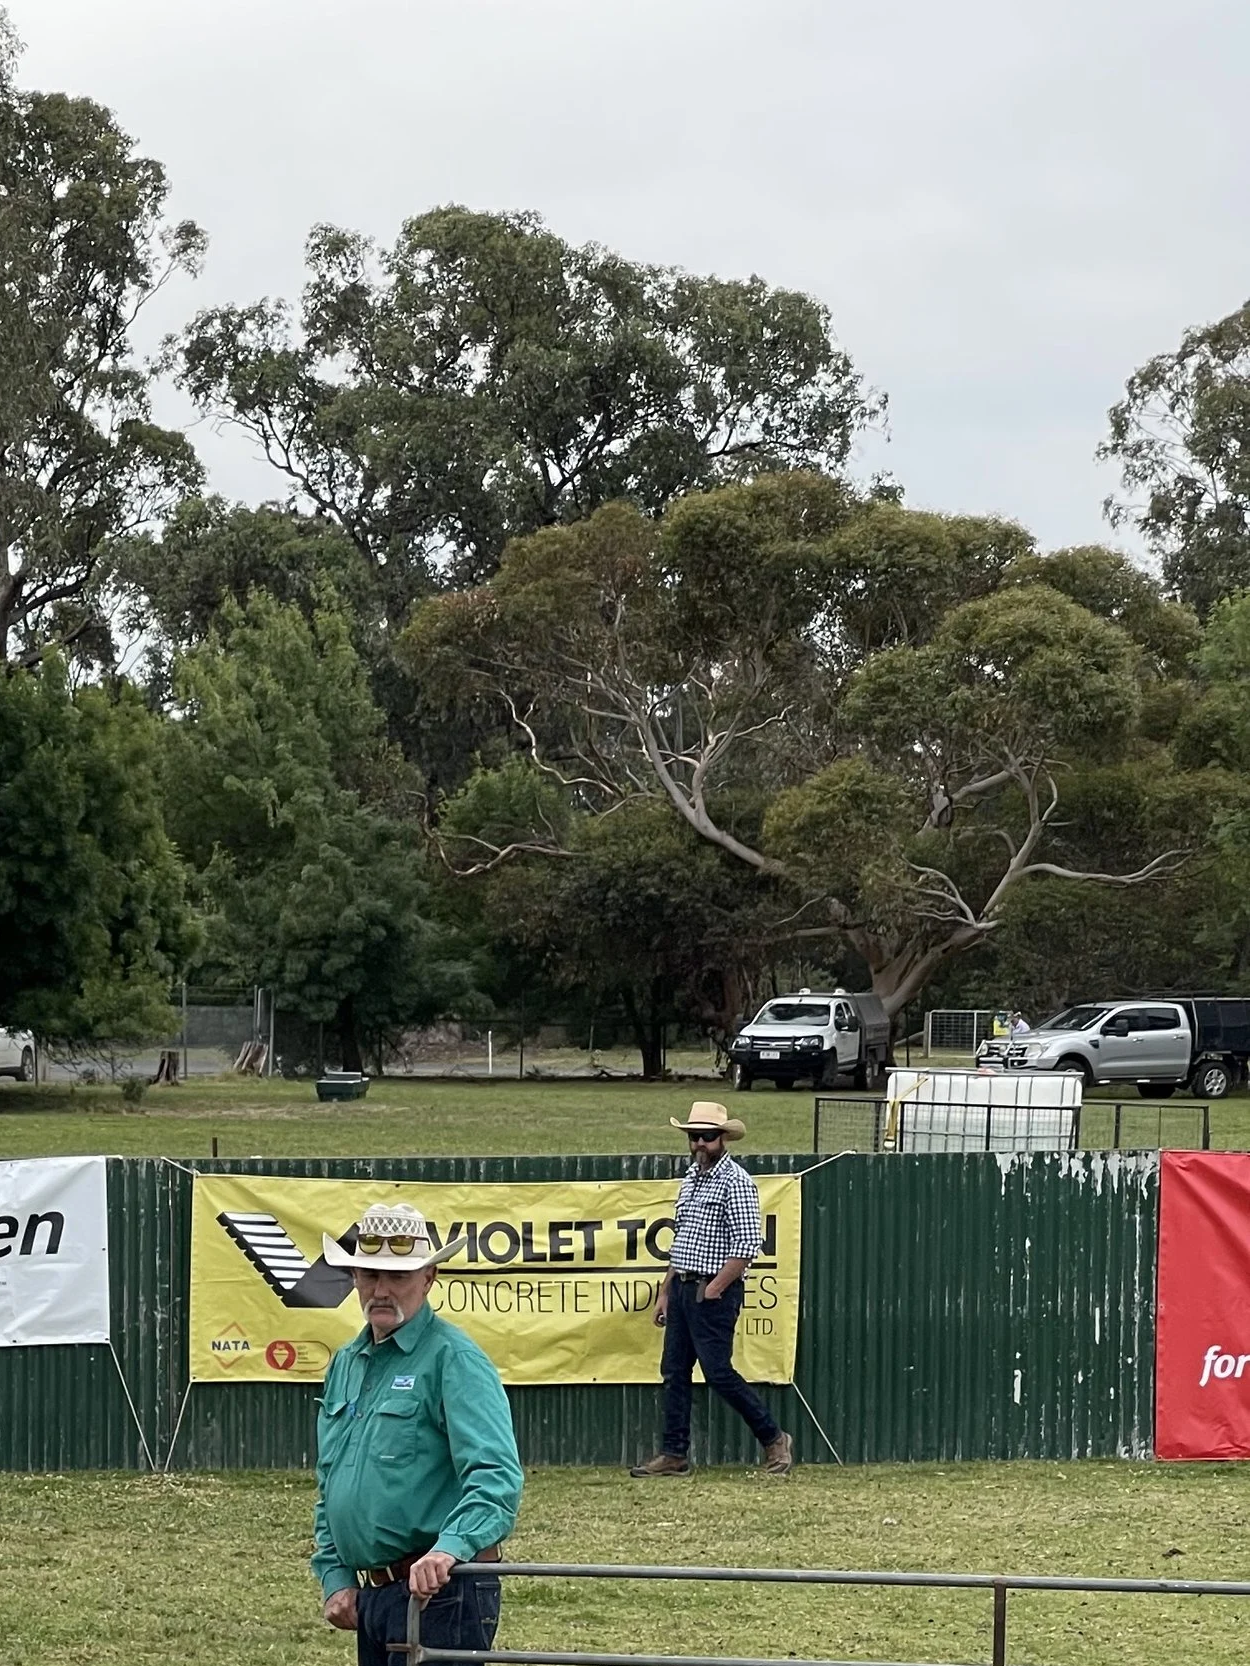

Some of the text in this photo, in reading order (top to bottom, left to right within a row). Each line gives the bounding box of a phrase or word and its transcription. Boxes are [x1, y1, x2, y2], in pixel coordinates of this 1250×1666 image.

[426, 1214, 777, 1264] VIOLET TON
[433, 1275, 778, 1314] CONCRETE INDES
[745, 1318, 778, 1336] LTD.
[211, 1340, 251, 1352] NATA
